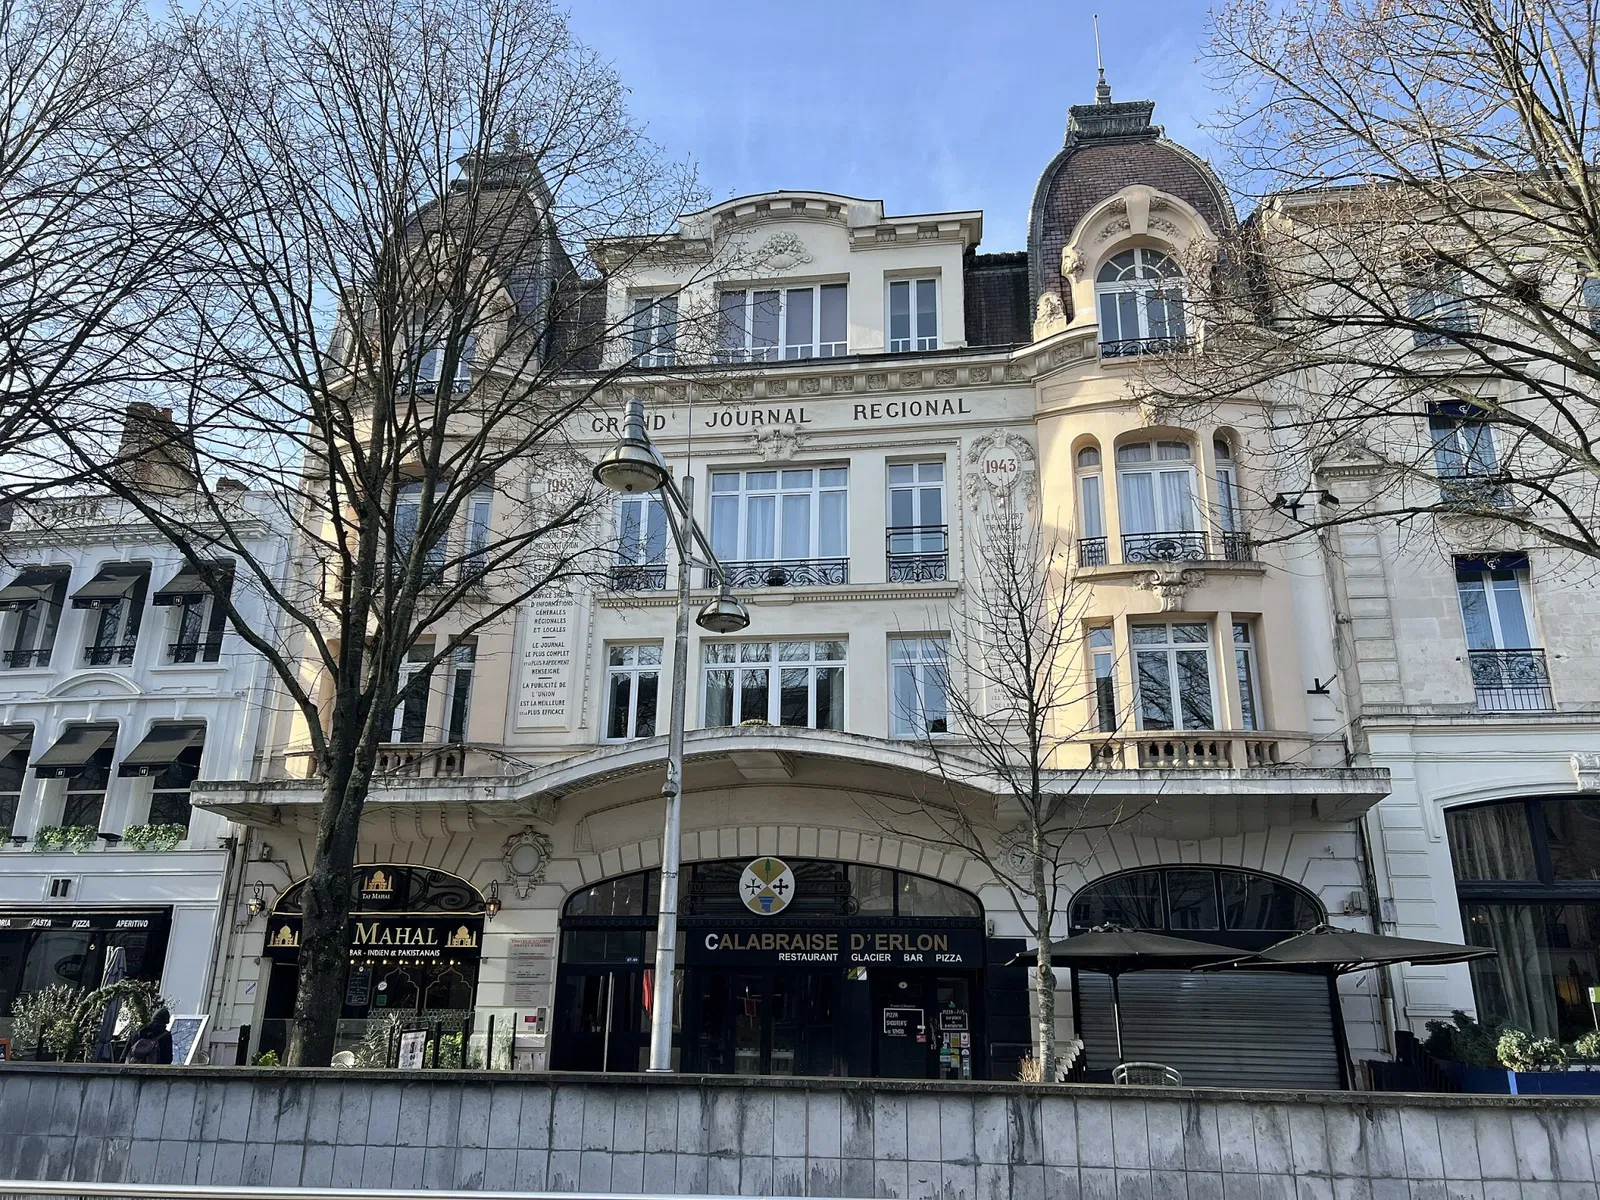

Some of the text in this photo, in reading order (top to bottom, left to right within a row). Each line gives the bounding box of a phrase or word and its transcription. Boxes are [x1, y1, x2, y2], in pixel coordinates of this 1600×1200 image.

[592, 398, 972, 433] GRND JOURNAL REGIONAL
[986, 459, 1016, 473] 1943
[50, 879, 72, 898] IT
[31, 918, 52, 927] PASTA
[71, 919, 90, 928] PIZZA
[116, 920, 149, 928] APERITIVO
[352, 922, 439, 945] MAHAL
[705, 933, 948, 951] CALABRAISE D'ERLON
[398, 949, 440, 957] PAKISTANAIS
[778, 952, 963, 963] RESTAURANT GLACIER BAR PIZZA
